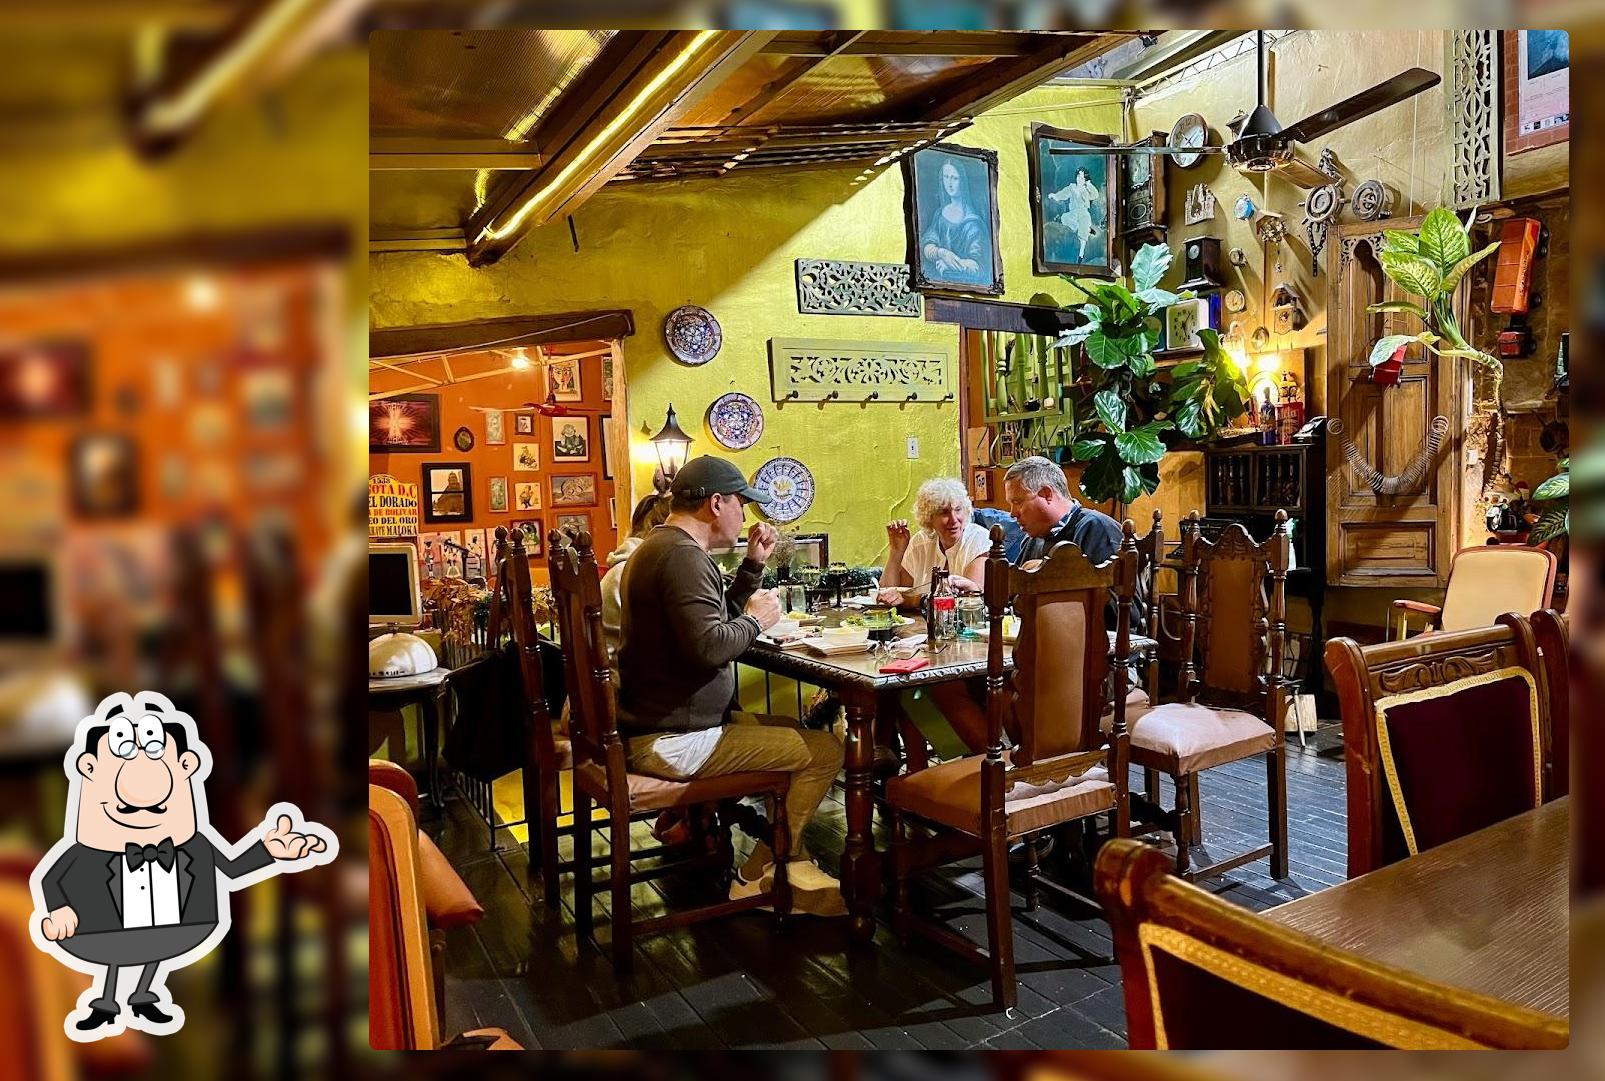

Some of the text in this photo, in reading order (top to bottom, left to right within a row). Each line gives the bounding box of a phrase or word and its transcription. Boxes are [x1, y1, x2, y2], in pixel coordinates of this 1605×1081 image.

[380, 496, 417, 508] DORADO
[381, 517, 397, 525] DEL
[399, 517, 417, 525] ORO
[386, 525, 417, 536] MALOKA
